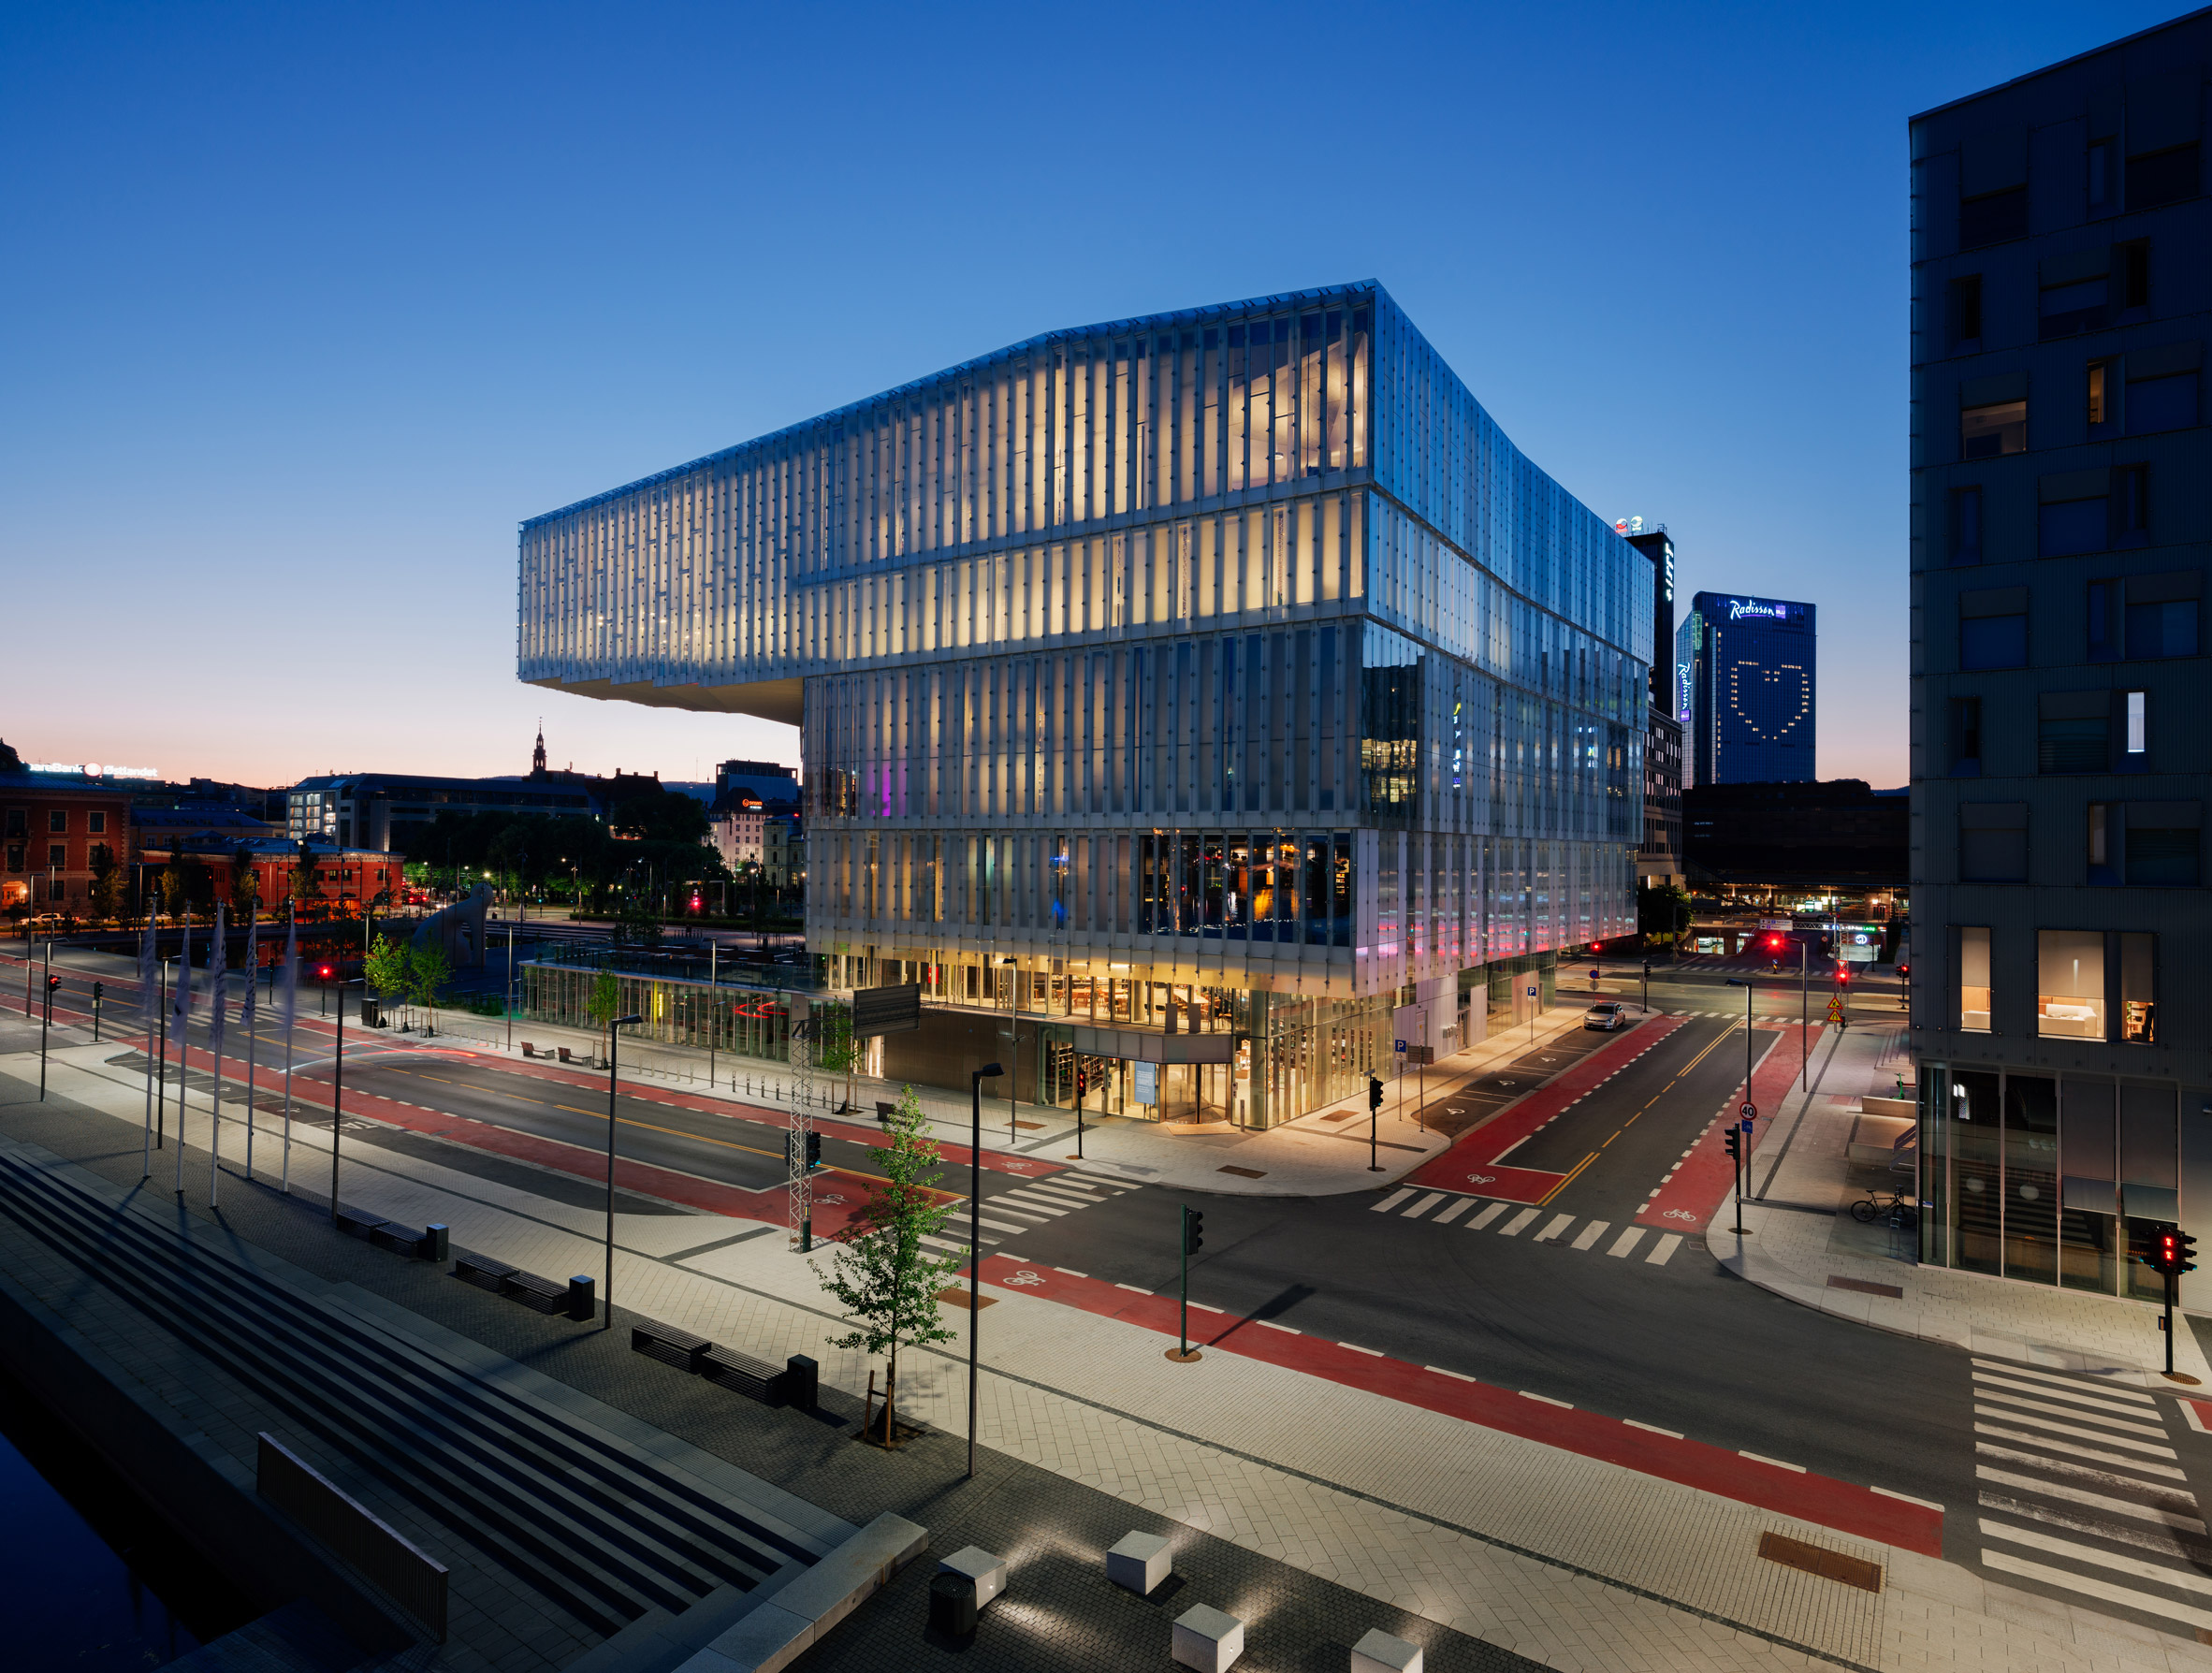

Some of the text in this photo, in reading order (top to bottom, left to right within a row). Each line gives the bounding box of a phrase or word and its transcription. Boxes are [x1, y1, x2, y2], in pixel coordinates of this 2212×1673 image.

[1729, 599, 1775, 620] Radisson
[1678, 662, 1692, 710] Radisson
[1529, 987, 1535, 996] P
[1397, 1040, 1404, 1051] P
[1741, 1106, 1754, 1117] 40
